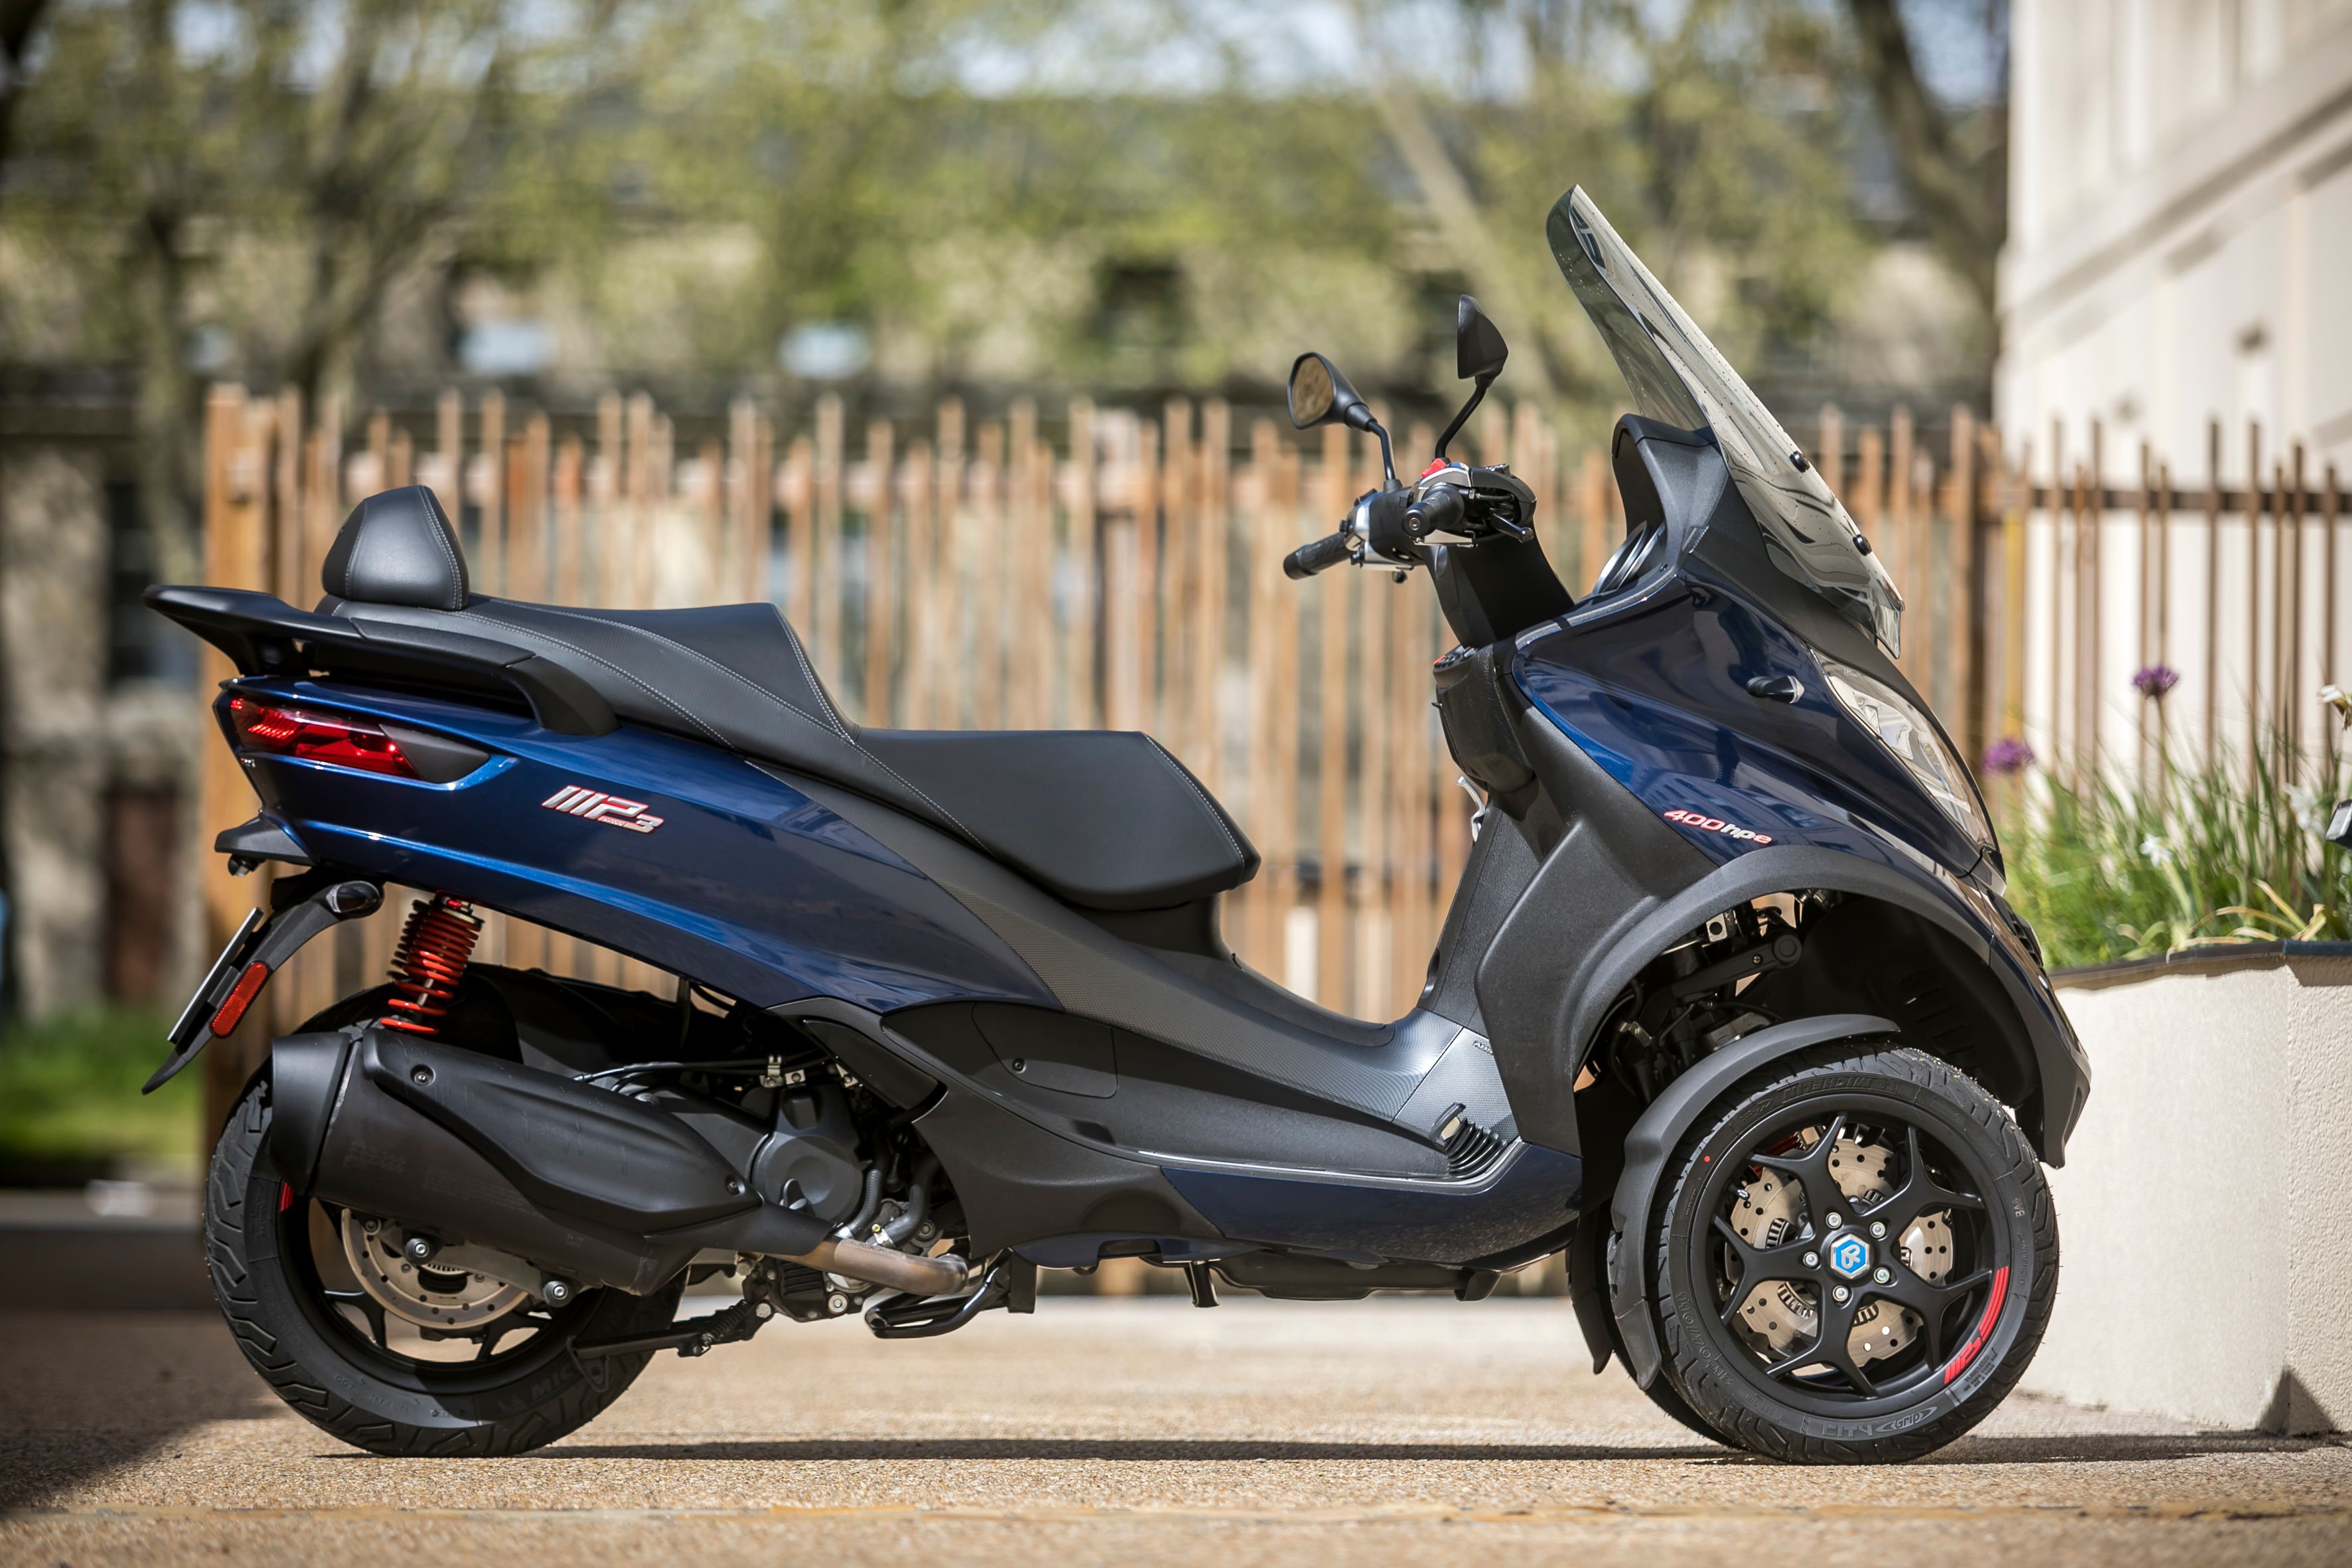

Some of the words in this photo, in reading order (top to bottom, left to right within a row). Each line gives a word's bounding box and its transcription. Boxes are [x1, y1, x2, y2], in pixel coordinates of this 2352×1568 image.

[542, 785, 665, 834] MP3
[1784, 1075, 1874, 1097] MICHELIN
[1822, 1423, 1873, 1438] CITY
